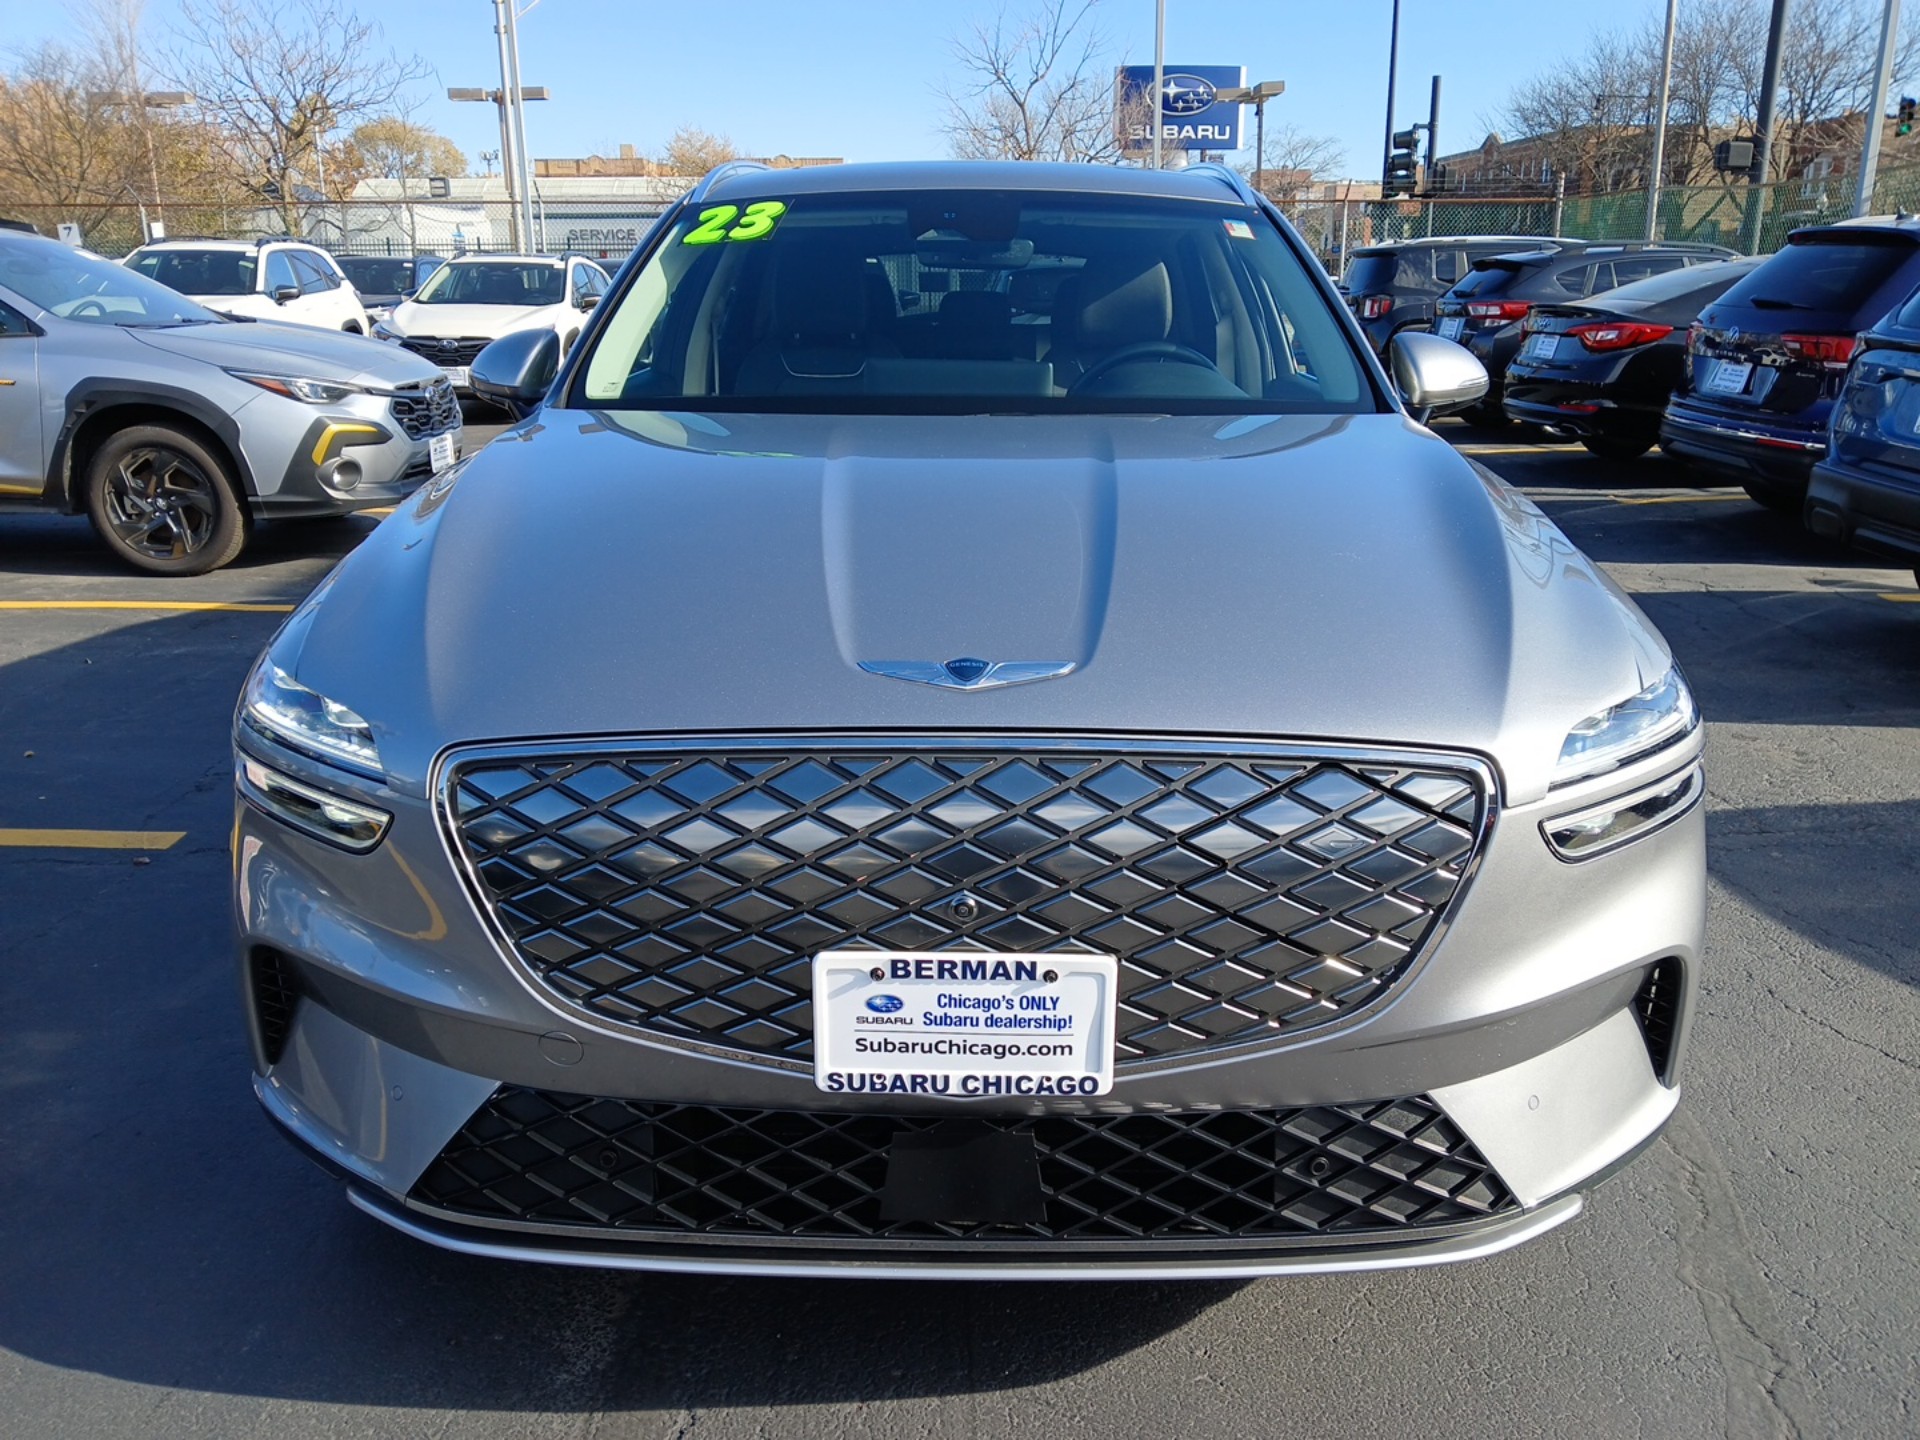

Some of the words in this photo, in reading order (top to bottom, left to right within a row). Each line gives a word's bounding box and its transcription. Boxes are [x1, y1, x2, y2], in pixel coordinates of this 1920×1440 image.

[1130, 125, 1230, 139] SUBARU
[63, 226, 72, 237] 7
[683, 201, 786, 244] 23
[568, 228, 636, 241] SERVICE
[890, 959, 1037, 981] BERMAN
[937, 993, 1014, 1011] Chicago's
[1019, 996, 1060, 1011] ONLY
[856, 1016, 913, 1025] SUBARU
[923, 1011, 979, 1028] Subaru
[984, 1014, 1073, 1032] dealership!
[855, 1037, 1073, 1059] SubaruChicago.com
[827, 1072, 950, 1093] SUBARU
[962, 1075, 1099, 1095] CHICAGO
